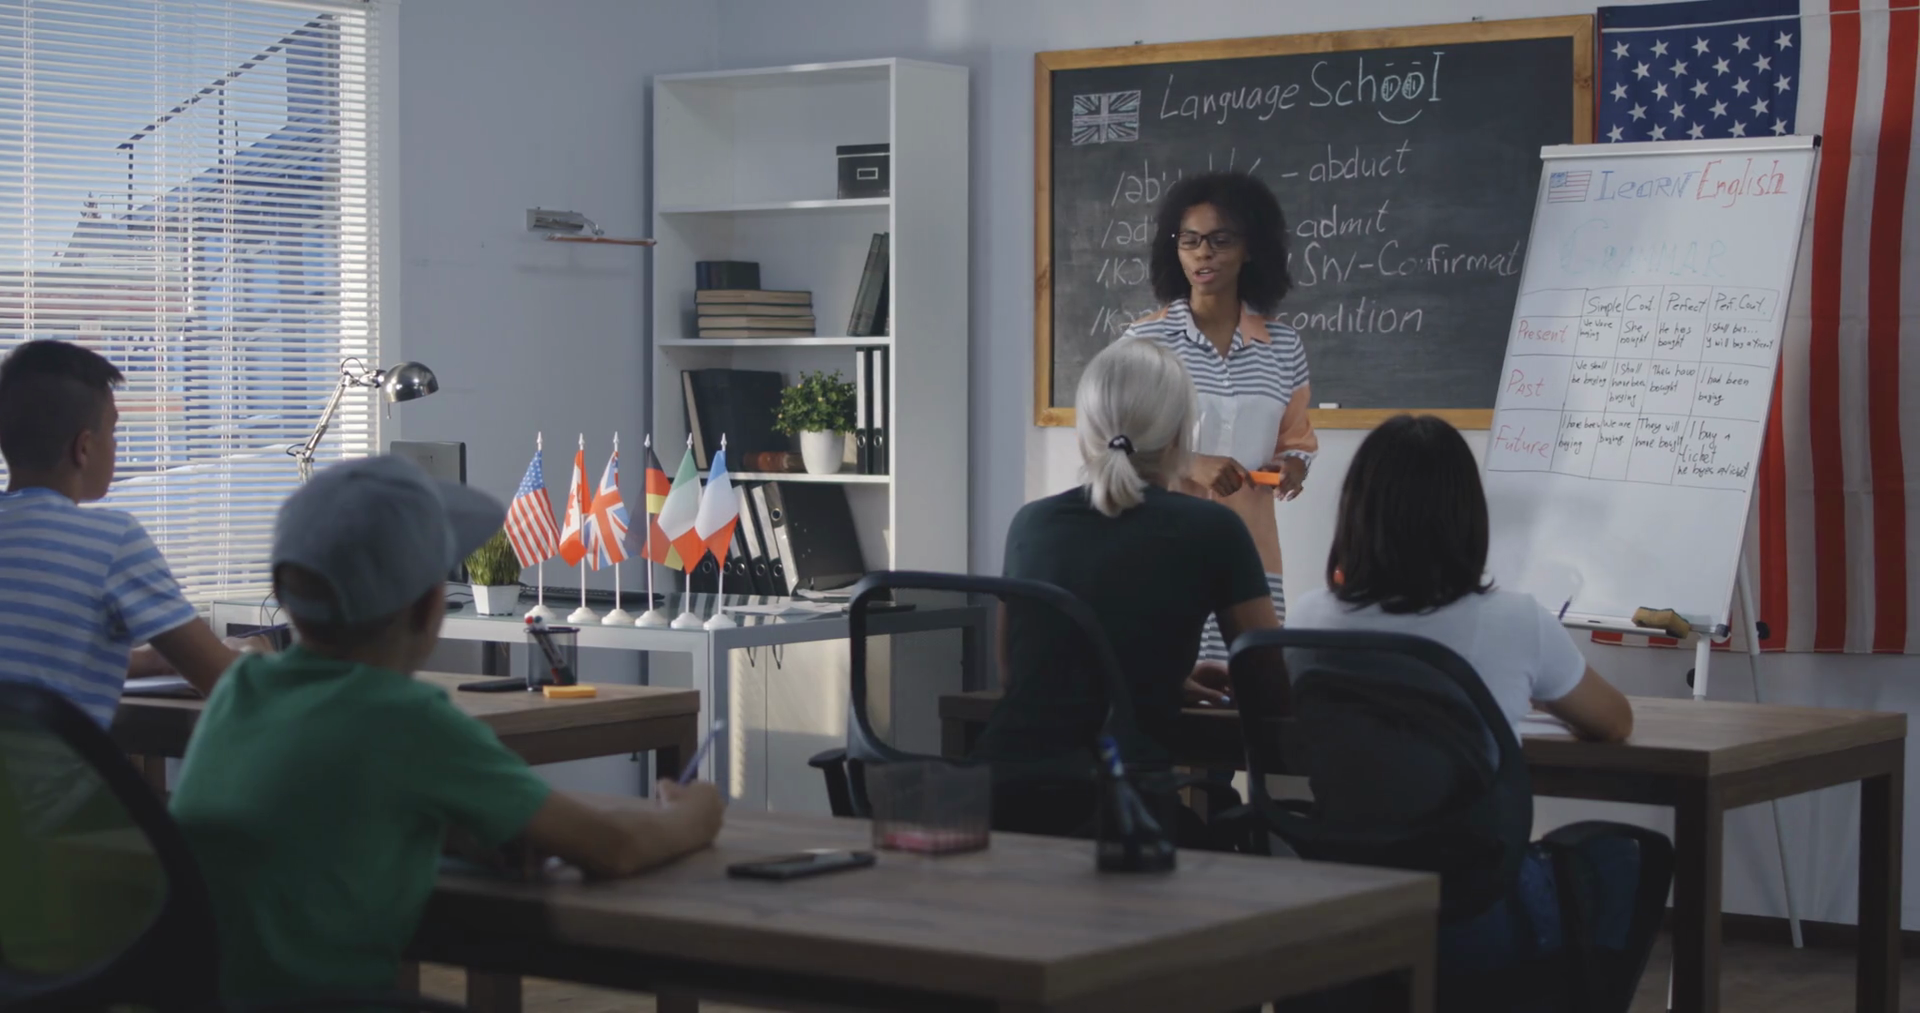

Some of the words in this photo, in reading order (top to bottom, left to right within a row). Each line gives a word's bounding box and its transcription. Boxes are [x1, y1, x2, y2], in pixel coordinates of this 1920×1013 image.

[1160, 74, 1299, 124] Language
[1309, 139, 1411, 182] abduct
[1696, 158, 1788, 208] English
[1296, 199, 1389, 238] admit
[1587, 296, 1621, 317] Simple
[1666, 292, 1707, 313] Perfect
[1517, 319, 1569, 343] Present
[1623, 320, 1642, 334] She
[1659, 322, 1670, 334] He
[1658, 334, 1685, 350] bought
[1707, 366, 1722, 385] had
[1726, 371, 1749, 386] been
[1649, 380, 1679, 396] bought
[1494, 424, 1550, 459] Future
[1698, 420, 1718, 450] buy
[1679, 443, 1717, 464] ticket
